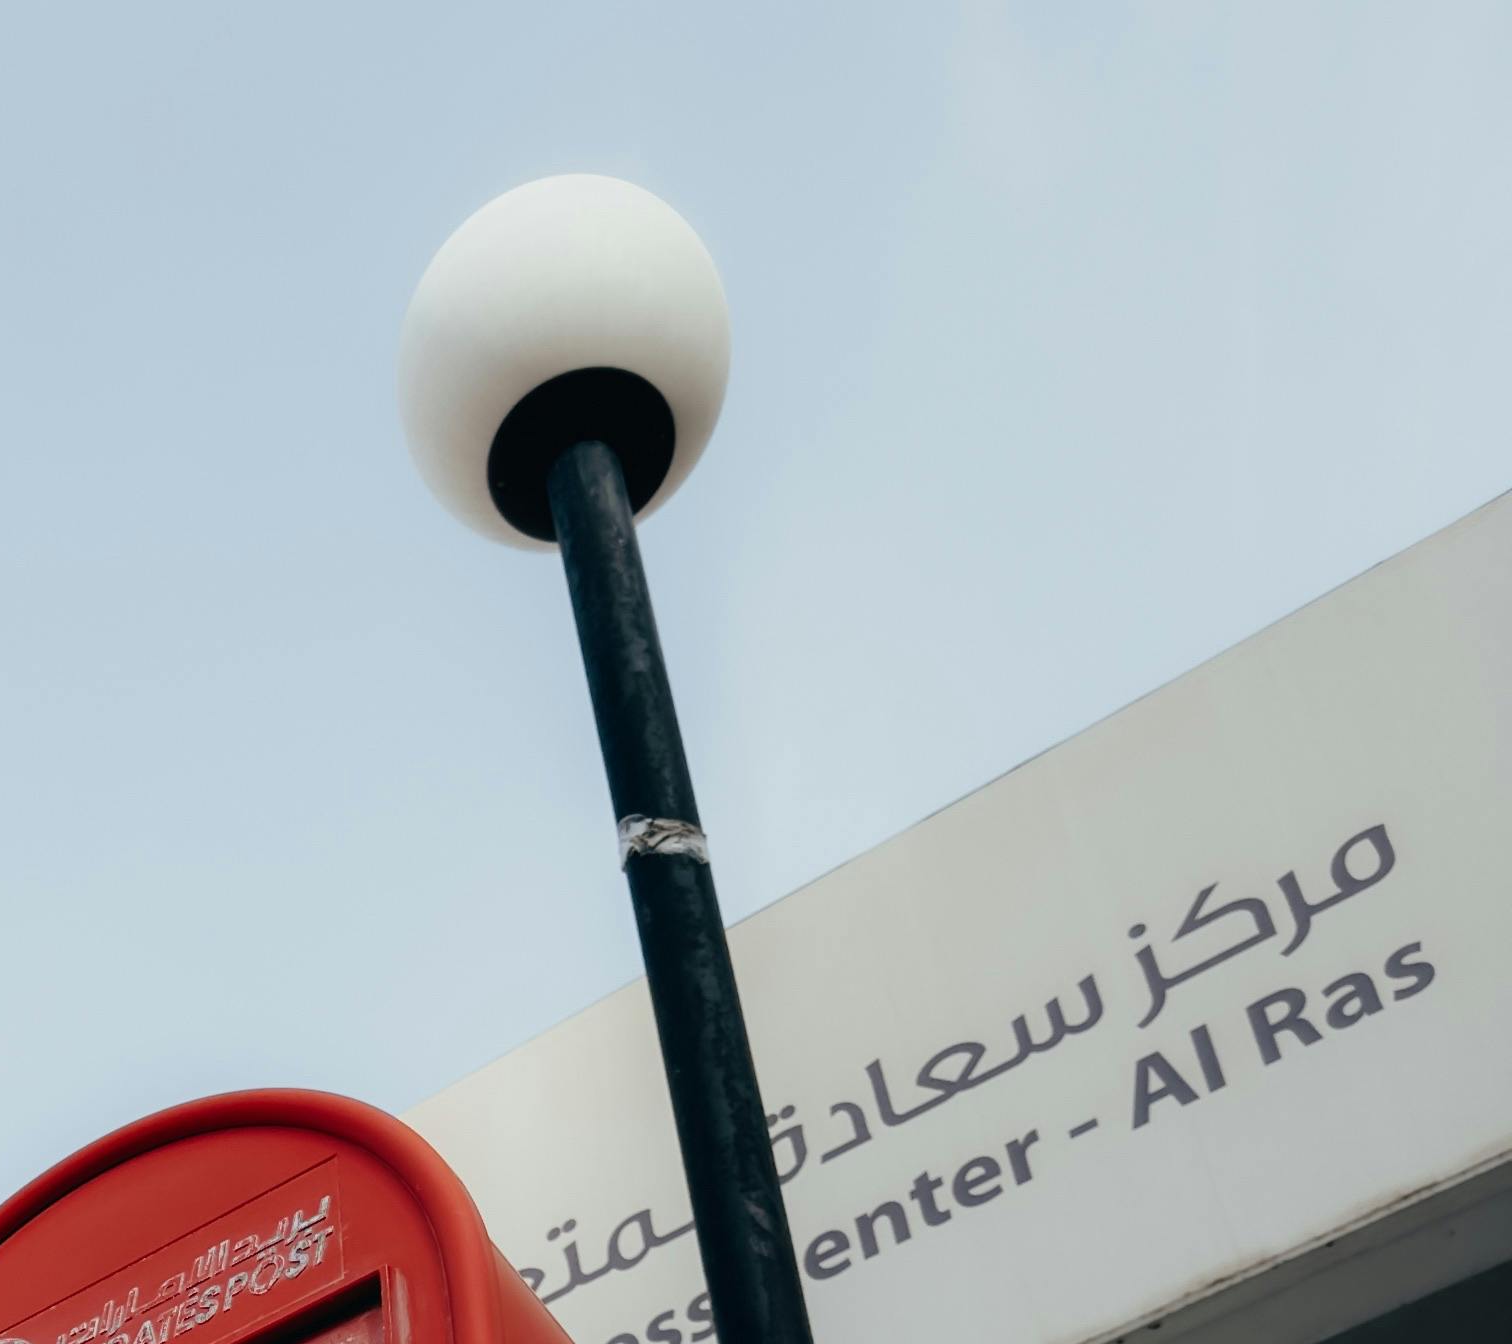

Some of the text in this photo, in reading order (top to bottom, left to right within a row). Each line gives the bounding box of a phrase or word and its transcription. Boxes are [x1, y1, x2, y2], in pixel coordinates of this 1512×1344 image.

[1127, 822, 1397, 1029] مركز
[766, 973, 1104, 1186] سعادة
[802, 1128, 1040, 1282] enter
[1131, 1022, 1228, 1131] Al
[1245, 940, 1437, 1067] Ras
[232, 1195, 331, 1267] بريد
